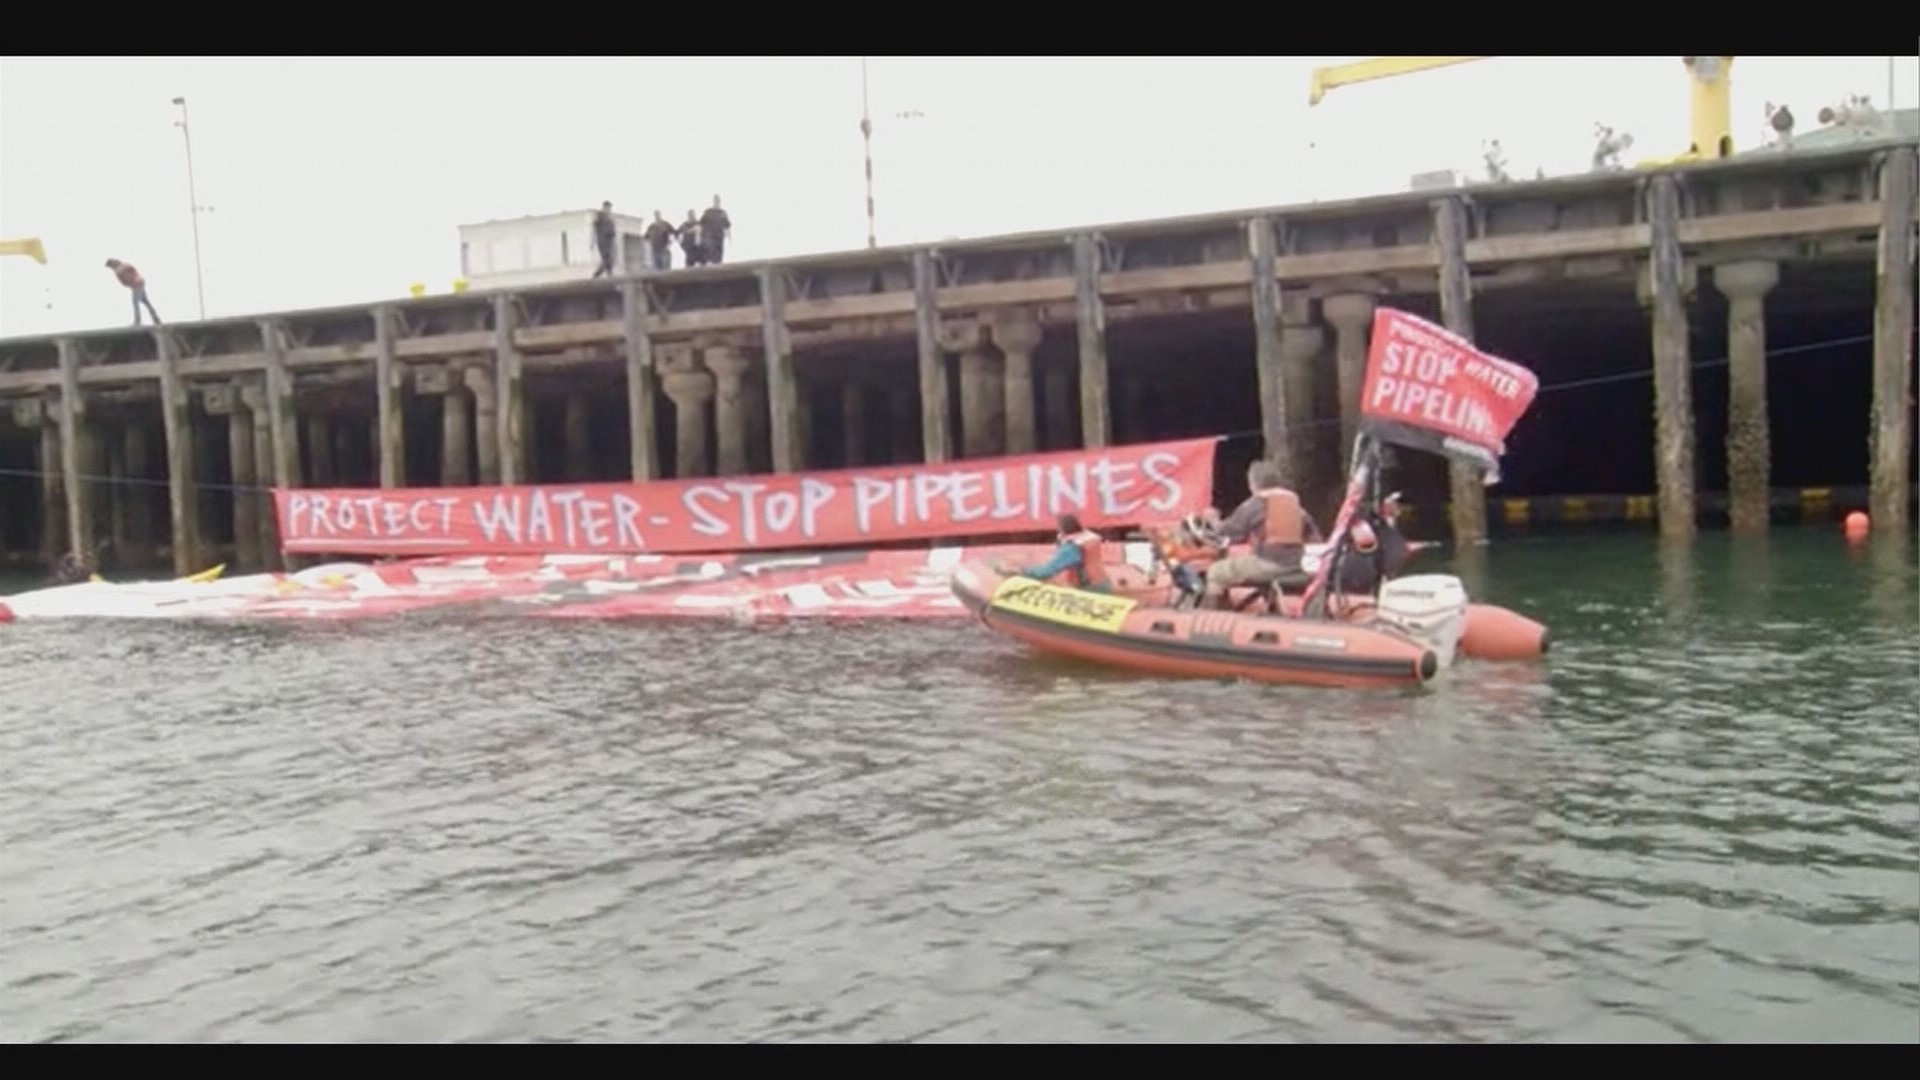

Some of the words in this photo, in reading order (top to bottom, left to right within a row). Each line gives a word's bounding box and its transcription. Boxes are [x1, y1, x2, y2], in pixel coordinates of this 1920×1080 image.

[1381, 340, 1456, 386] STOP
[1463, 359, 1521, 400] WATER
[1371, 376, 1495, 438] PIPELIN
[285, 495, 460, 537] PROTECT
[682, 480, 835, 545] STOP
[852, 452, 1181, 534] PIPELINES
